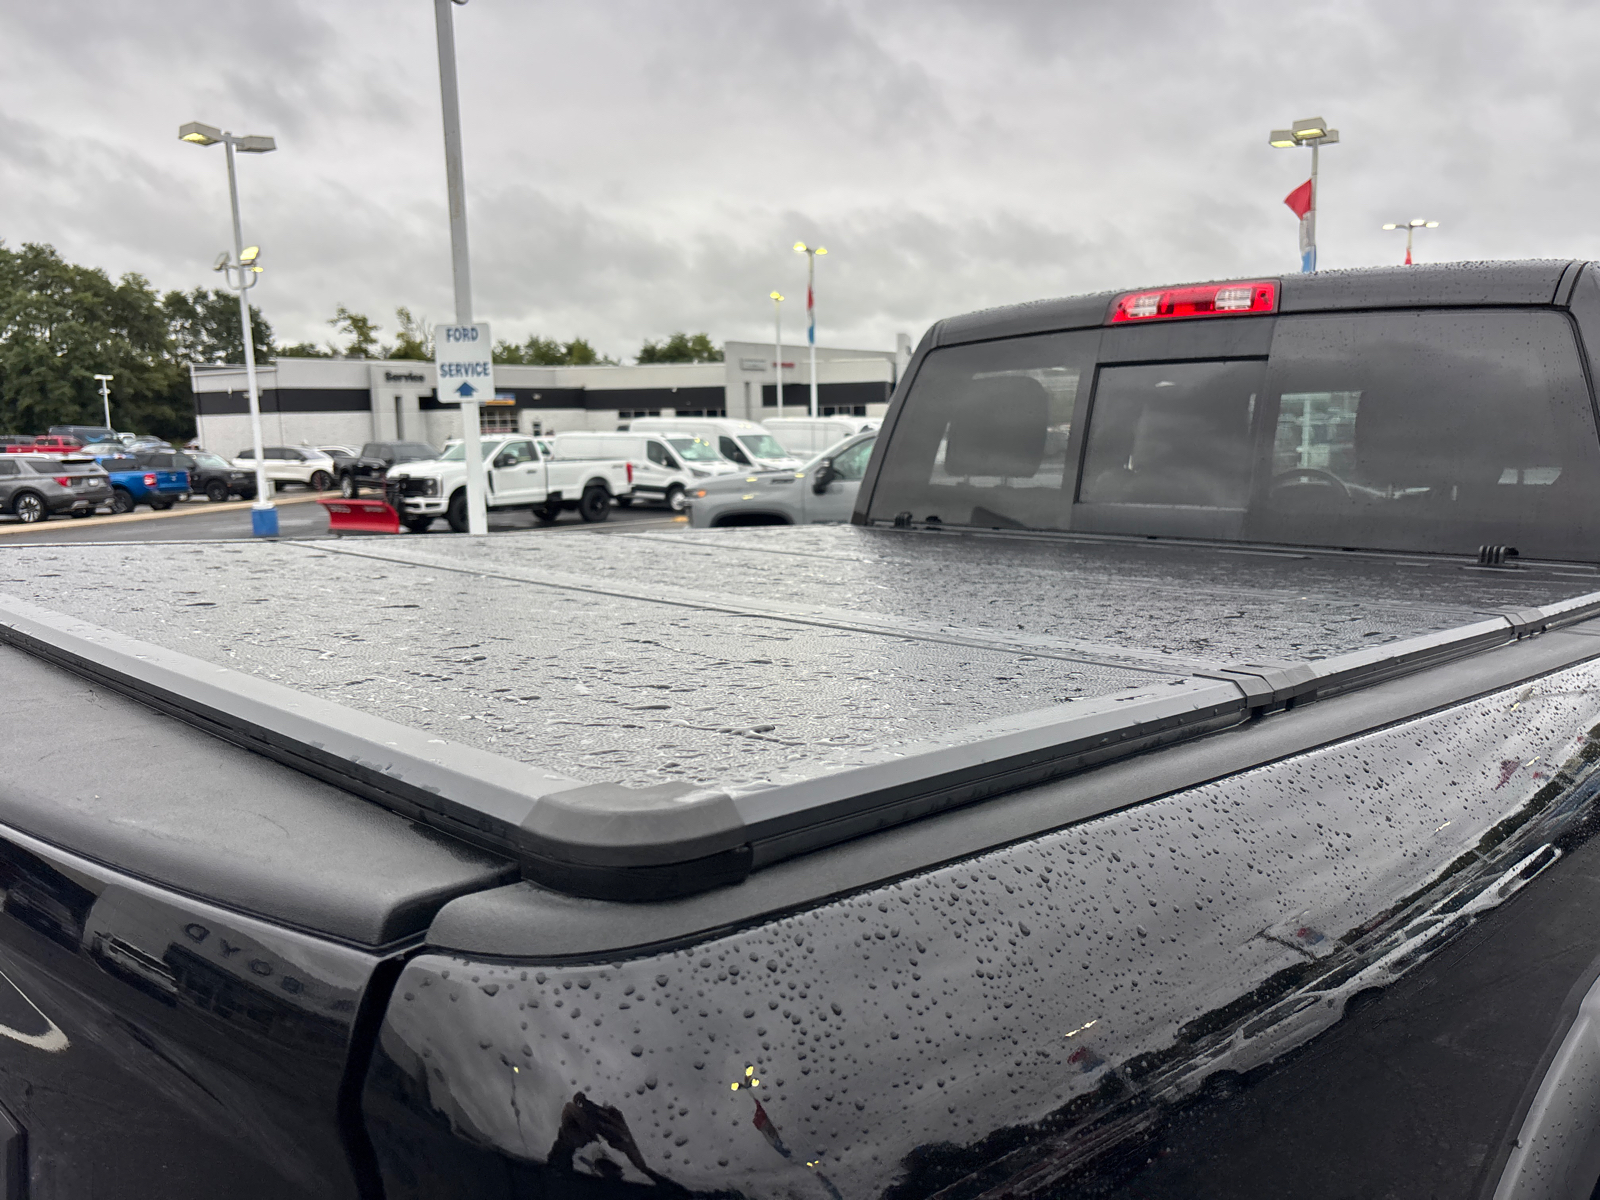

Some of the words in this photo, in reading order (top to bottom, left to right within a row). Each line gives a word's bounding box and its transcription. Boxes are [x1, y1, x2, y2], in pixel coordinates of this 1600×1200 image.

[446, 327, 479, 343] FORD
[385, 372, 425, 382] Service
[440, 361, 490, 378] SERVICE
